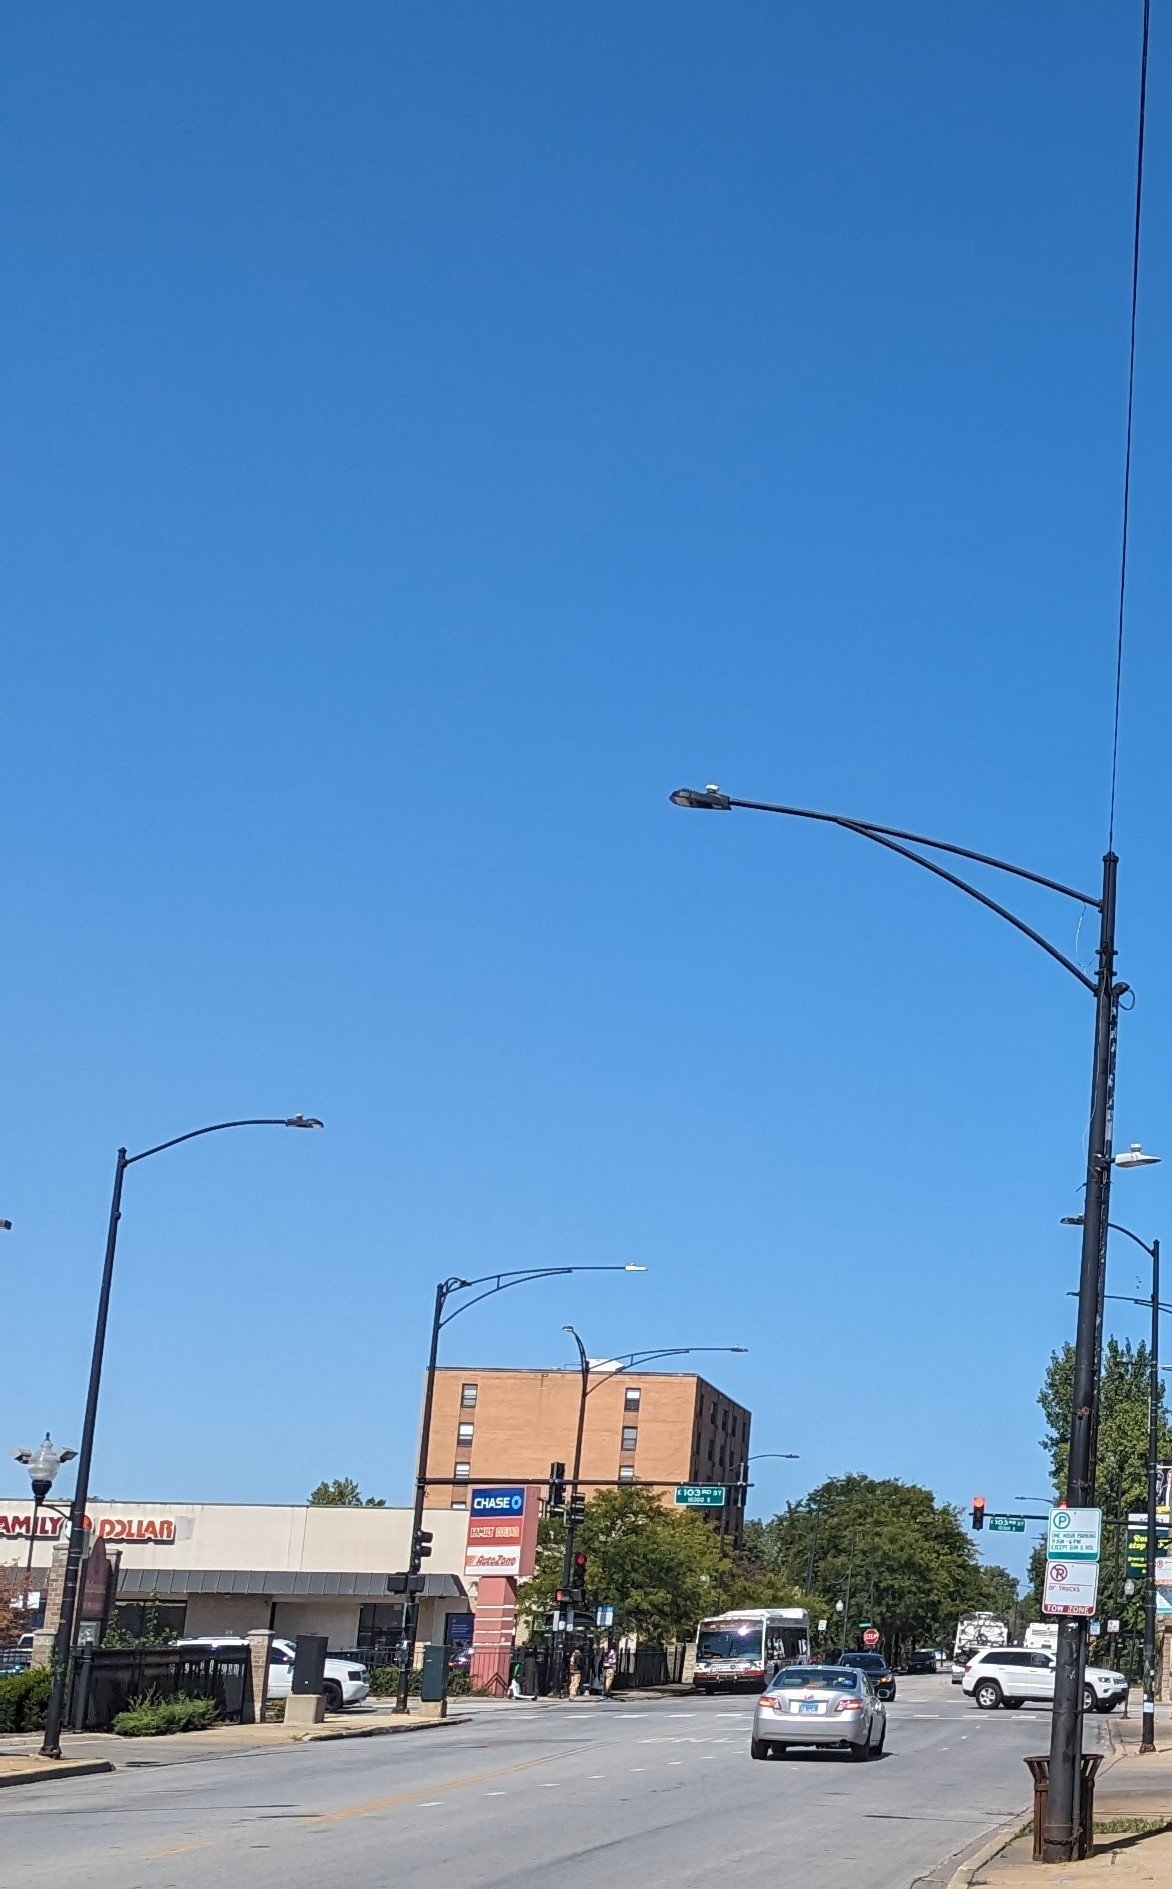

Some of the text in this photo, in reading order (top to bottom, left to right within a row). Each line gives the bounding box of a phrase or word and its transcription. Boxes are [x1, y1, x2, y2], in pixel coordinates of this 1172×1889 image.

[473, 1497, 511, 1509] CHASE
[0, 1516, 173, 1539] AMILY DOLLAR
[1046, 1604, 1090, 1615] TOW ZONE
[864, 1632, 879, 1640] STOP
